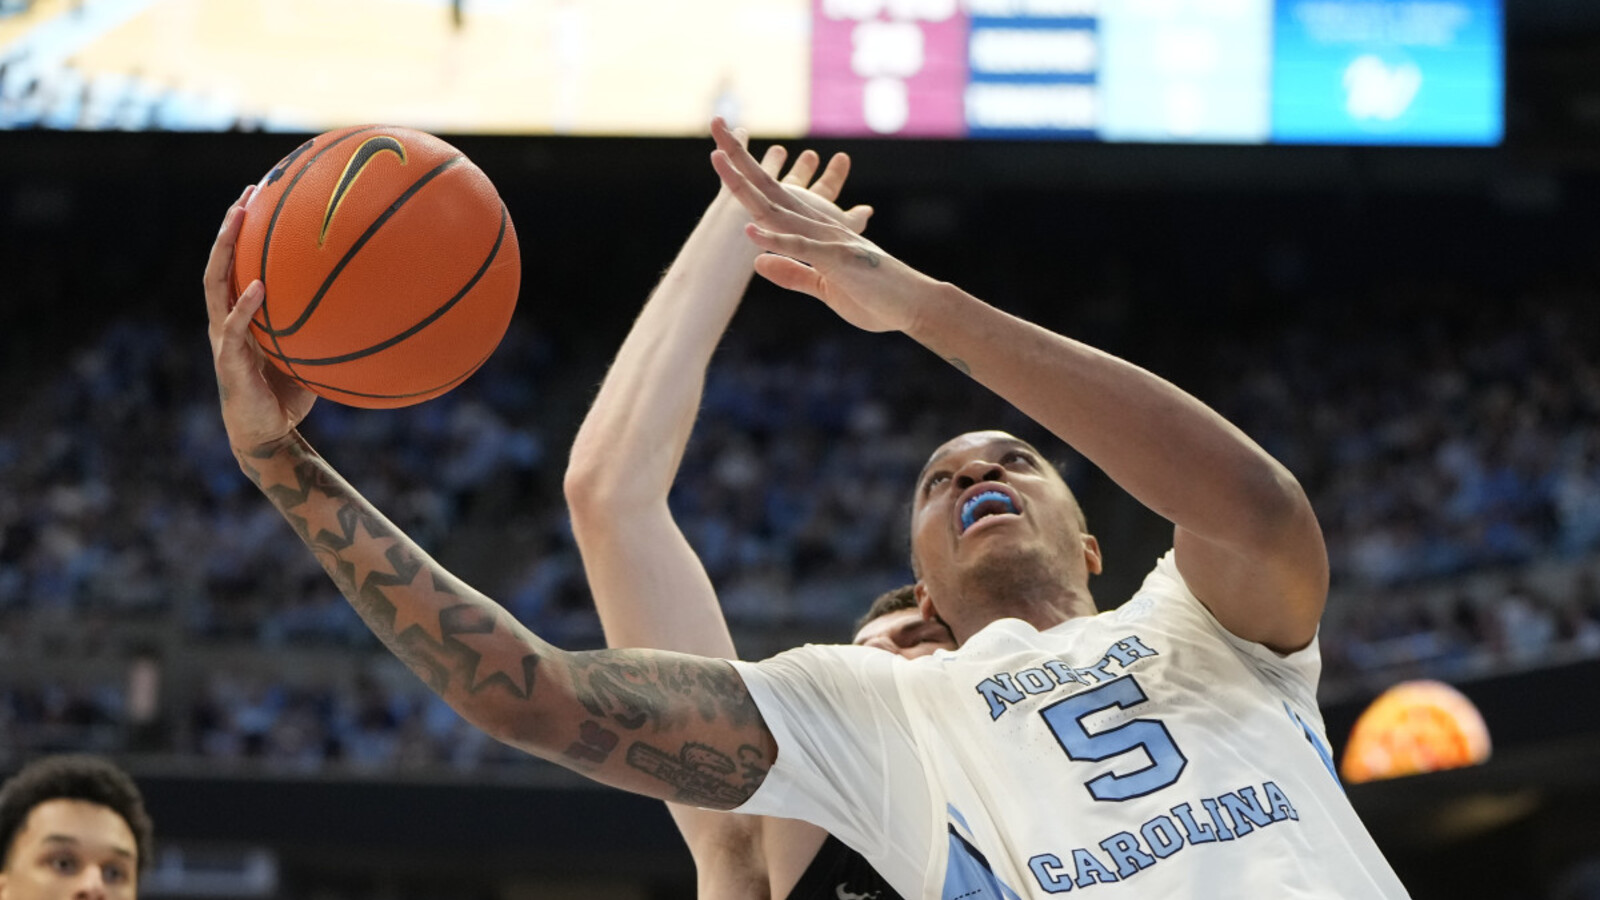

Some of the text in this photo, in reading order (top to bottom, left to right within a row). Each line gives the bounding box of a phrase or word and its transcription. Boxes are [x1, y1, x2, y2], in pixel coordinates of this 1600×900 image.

[976, 635, 1159, 721] NORTH
[1039, 674, 1188, 802] 5
[1028, 781, 1299, 894] CAROLINA
